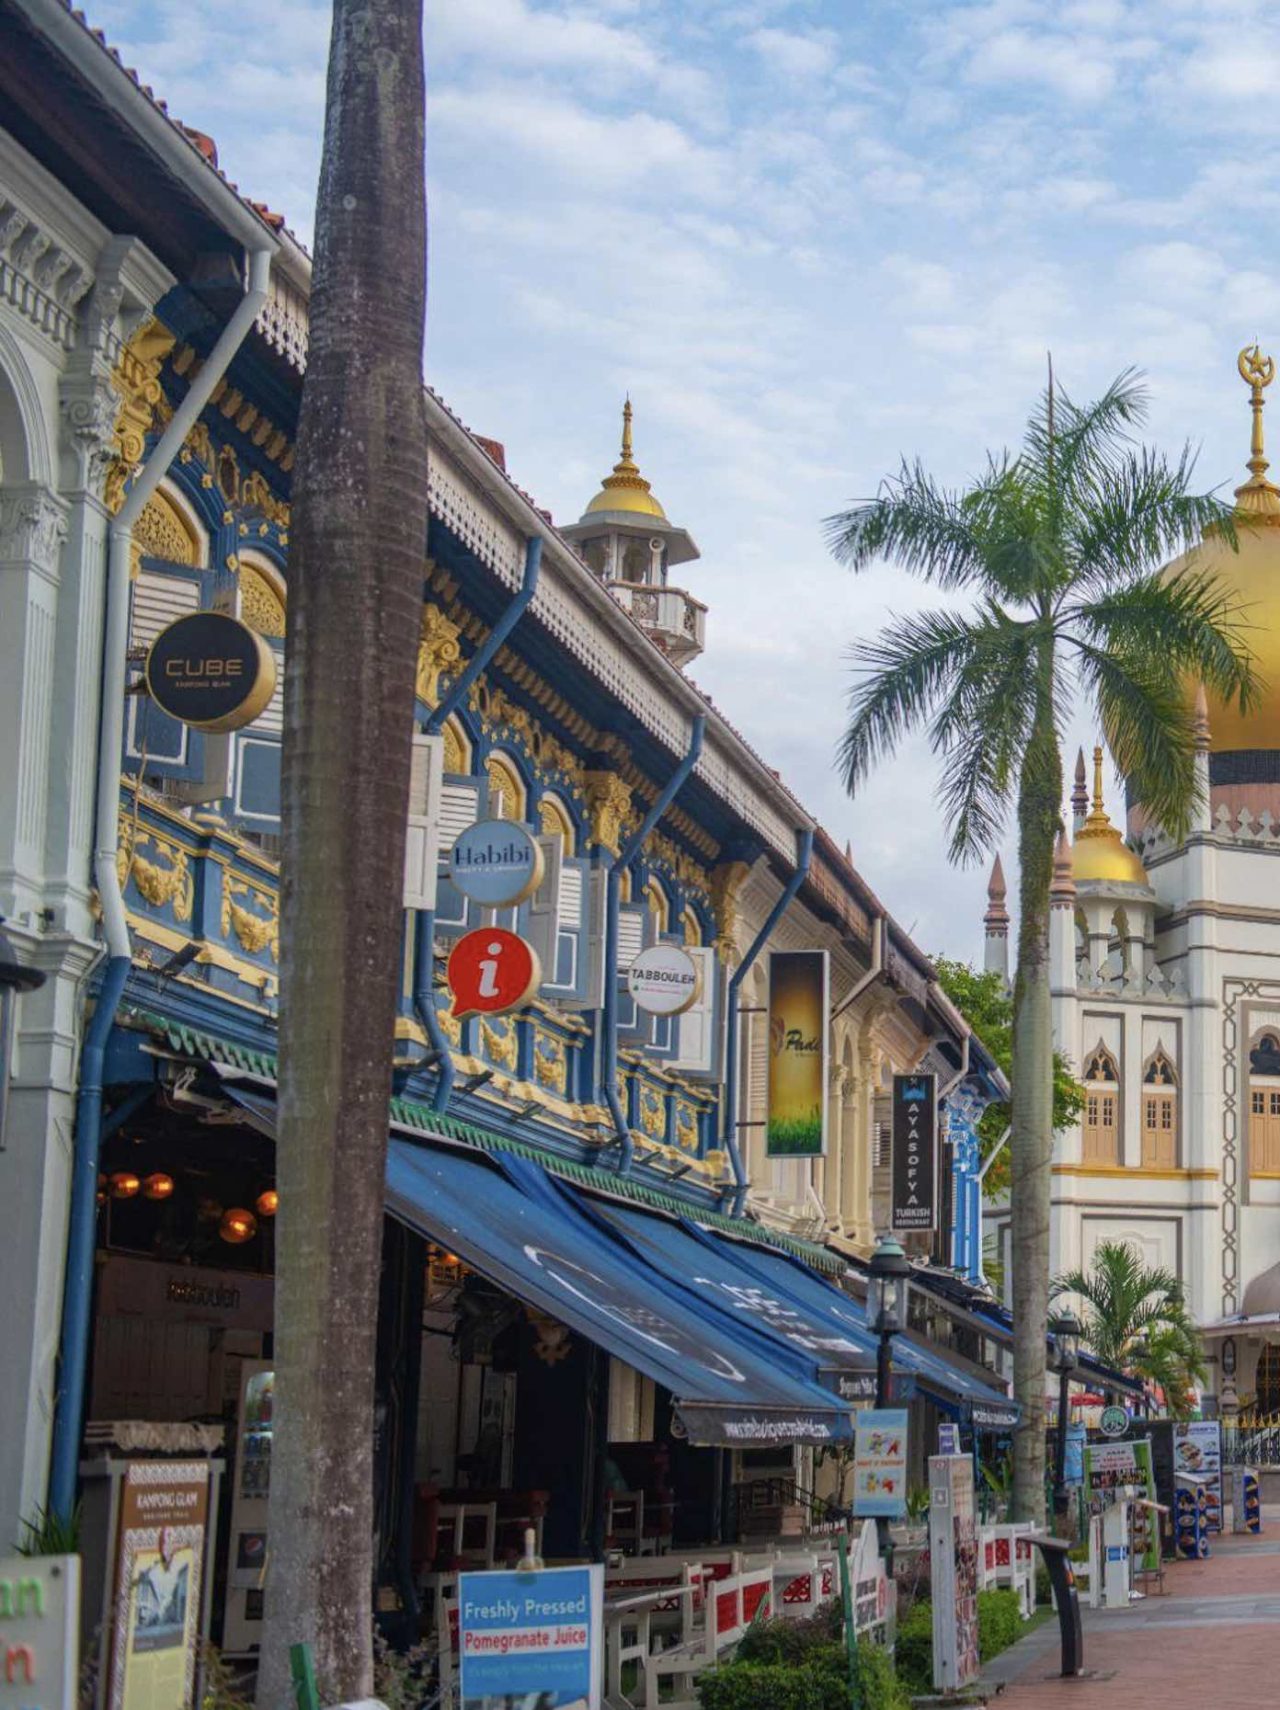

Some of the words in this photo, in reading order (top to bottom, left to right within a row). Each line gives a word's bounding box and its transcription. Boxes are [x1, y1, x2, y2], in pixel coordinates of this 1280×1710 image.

[166, 659, 243, 676] CUBE
[455, 843, 529, 865] Habibi
[631, 968, 696, 984] TABBOULEH
[907, 1103, 920, 1205] AYASOFYA
[895, 1208, 931, 1218] TURKISH
[136, 1494, 175, 1509] KAMPONG
[175, 1492, 198, 1507] GLAM
[464, 1600, 520, 1622] Freshly
[525, 1595, 586, 1616] Pressed
[464, 1630, 550, 1653] Pomegranate
[553, 1626, 586, 1646] Juice
